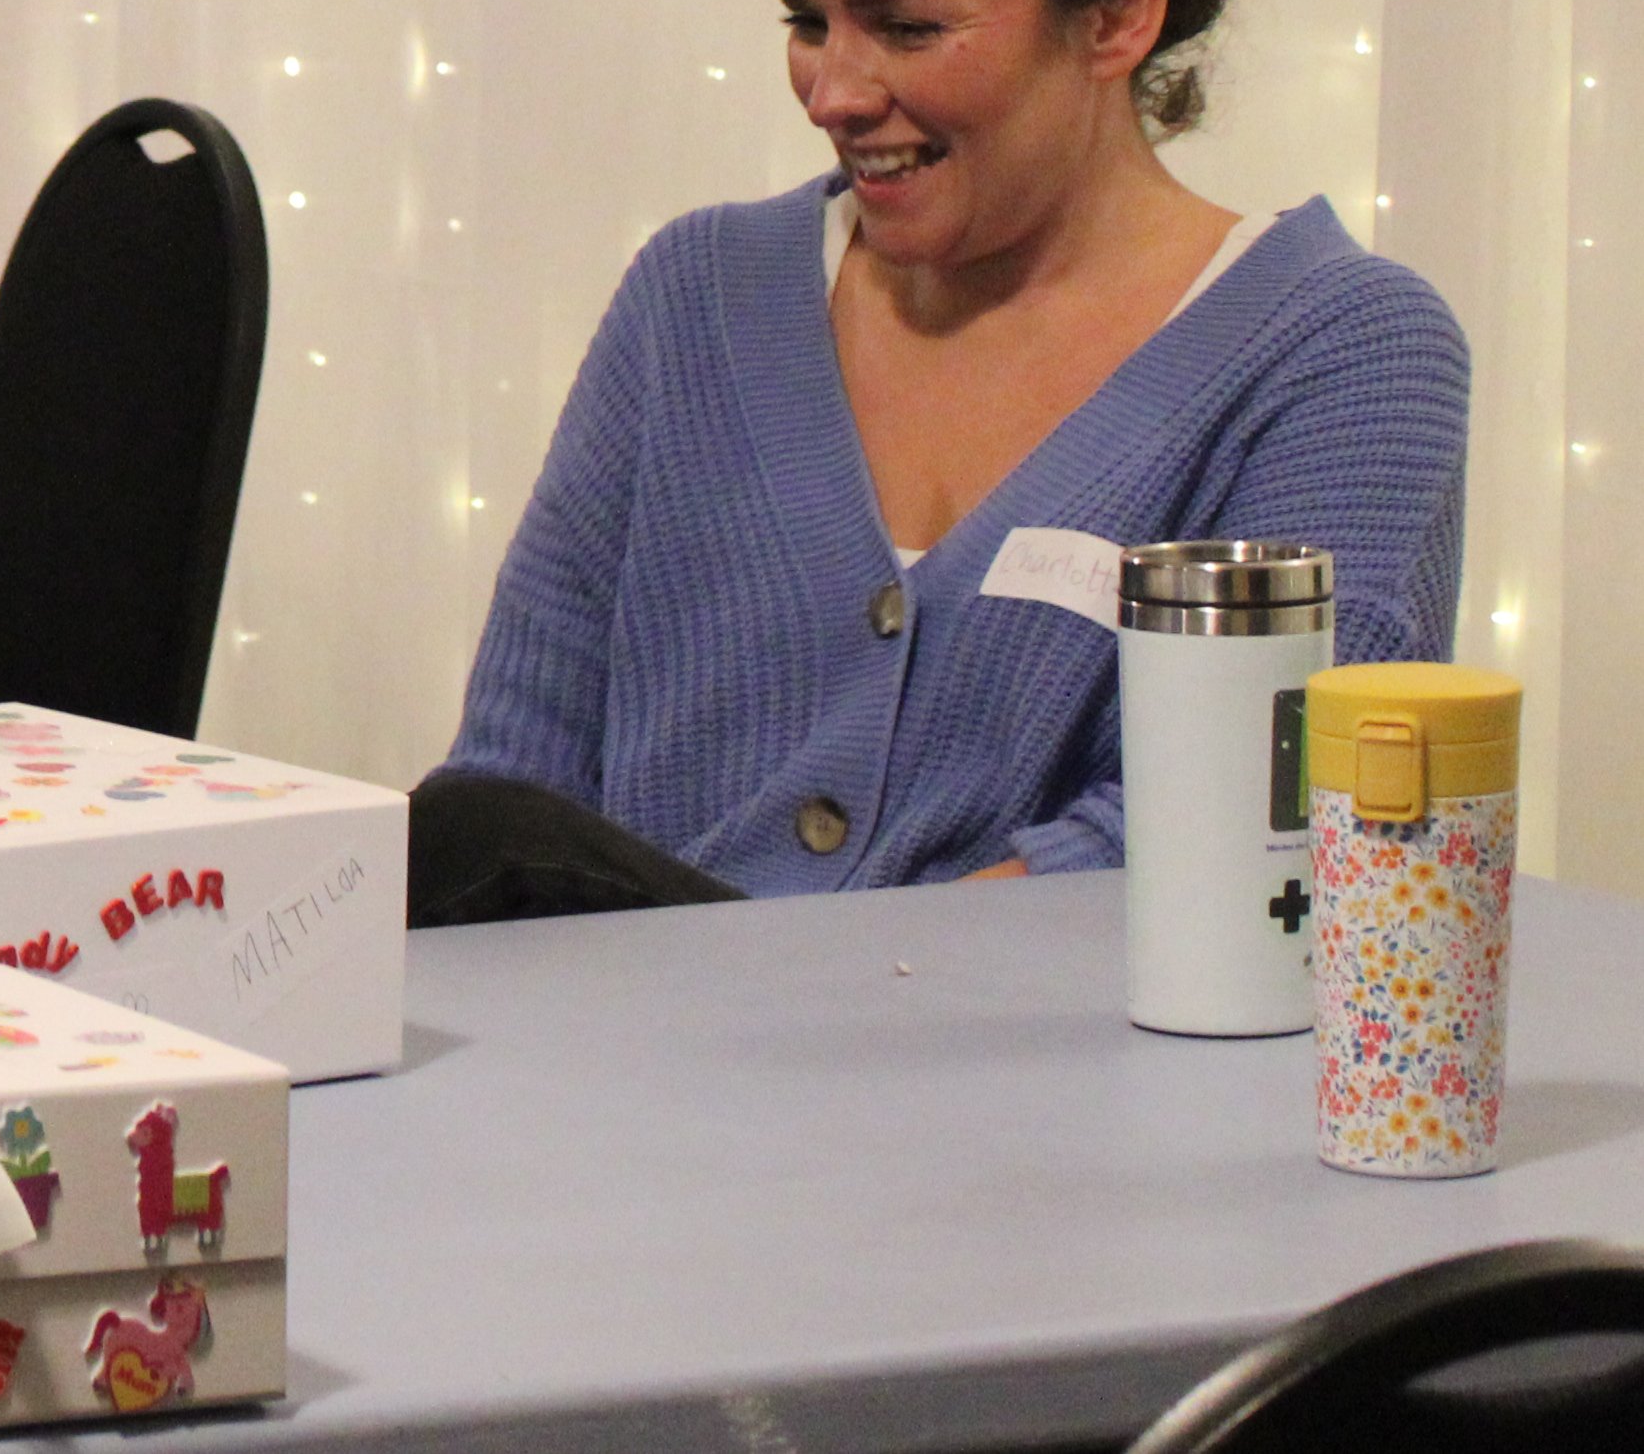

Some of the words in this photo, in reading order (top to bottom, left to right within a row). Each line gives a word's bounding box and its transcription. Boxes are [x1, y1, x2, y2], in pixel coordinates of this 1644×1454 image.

[998, 541, 1121, 596] Charlott
[100, 868, 225, 942] BEAR
[232, 857, 365, 1004] MATILDA
